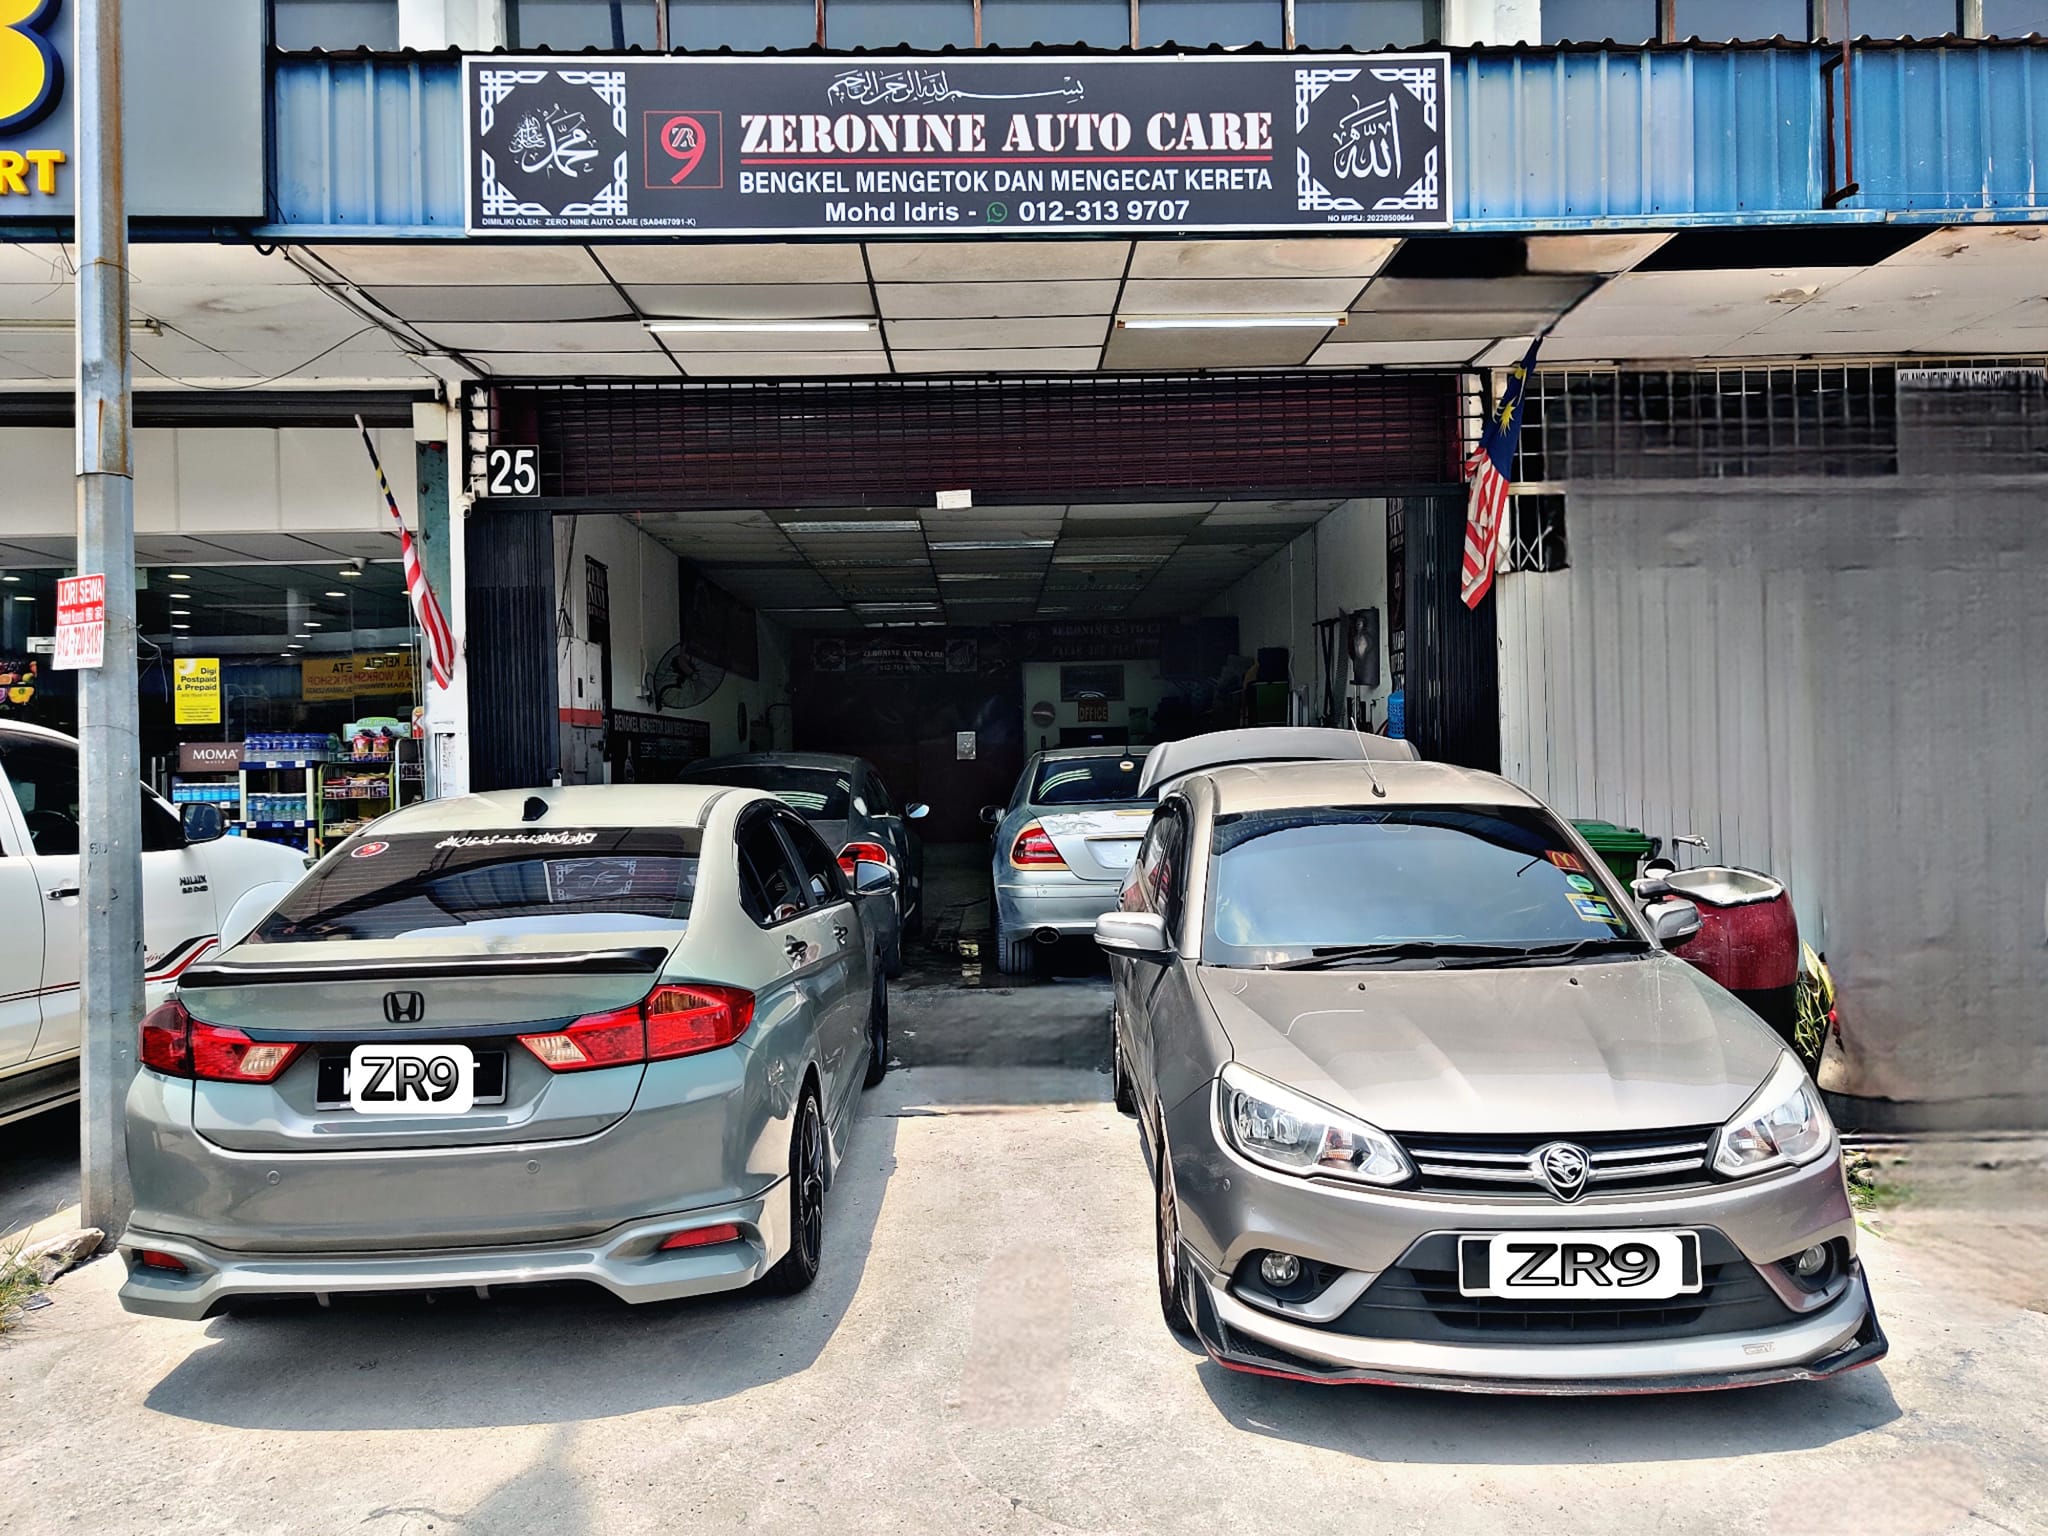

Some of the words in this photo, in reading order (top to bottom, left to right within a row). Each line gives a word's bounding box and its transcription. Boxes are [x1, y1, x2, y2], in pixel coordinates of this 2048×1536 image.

[740, 113, 987, 154] ZERONINE
[1001, 112, 1132, 152] AUTO
[1146, 111, 1273, 151] CARE
[739, 170, 850, 194] BENGKEL
[856, 170, 989, 193] MENGETOK
[995, 169, 1043, 192] DAN
[1051, 168, 1179, 192] MENGECAT
[1185, 168, 1273, 190] KERETA
[825, 202, 895, 222] Mohd
[904, 201, 960, 222] Idris
[1018, 200, 1120, 222] 012-313
[1127, 199, 1190, 221] 9707
[482, 217, 515, 226] DIMILIKI
[516, 217, 541, 226] OLEH:
[545, 217, 568, 226] ZERO
[570, 217, 589, 226] NINE
[591, 217, 614, 226] AUTO
[616, 217, 638, 226] CARE
[1327, 214, 1339, 222] NO
[490, 449, 536, 494] 25
[60, 582, 78, 606] LORI
[79, 577, 103, 603] SEWA
[200, 667, 216, 676] Digi
[180, 675, 217, 684] Postpaid
[185, 683, 217, 692] Prepaid
[1079, 706, 1108, 720] OFFICE
[193, 748, 237, 760] MOMA
